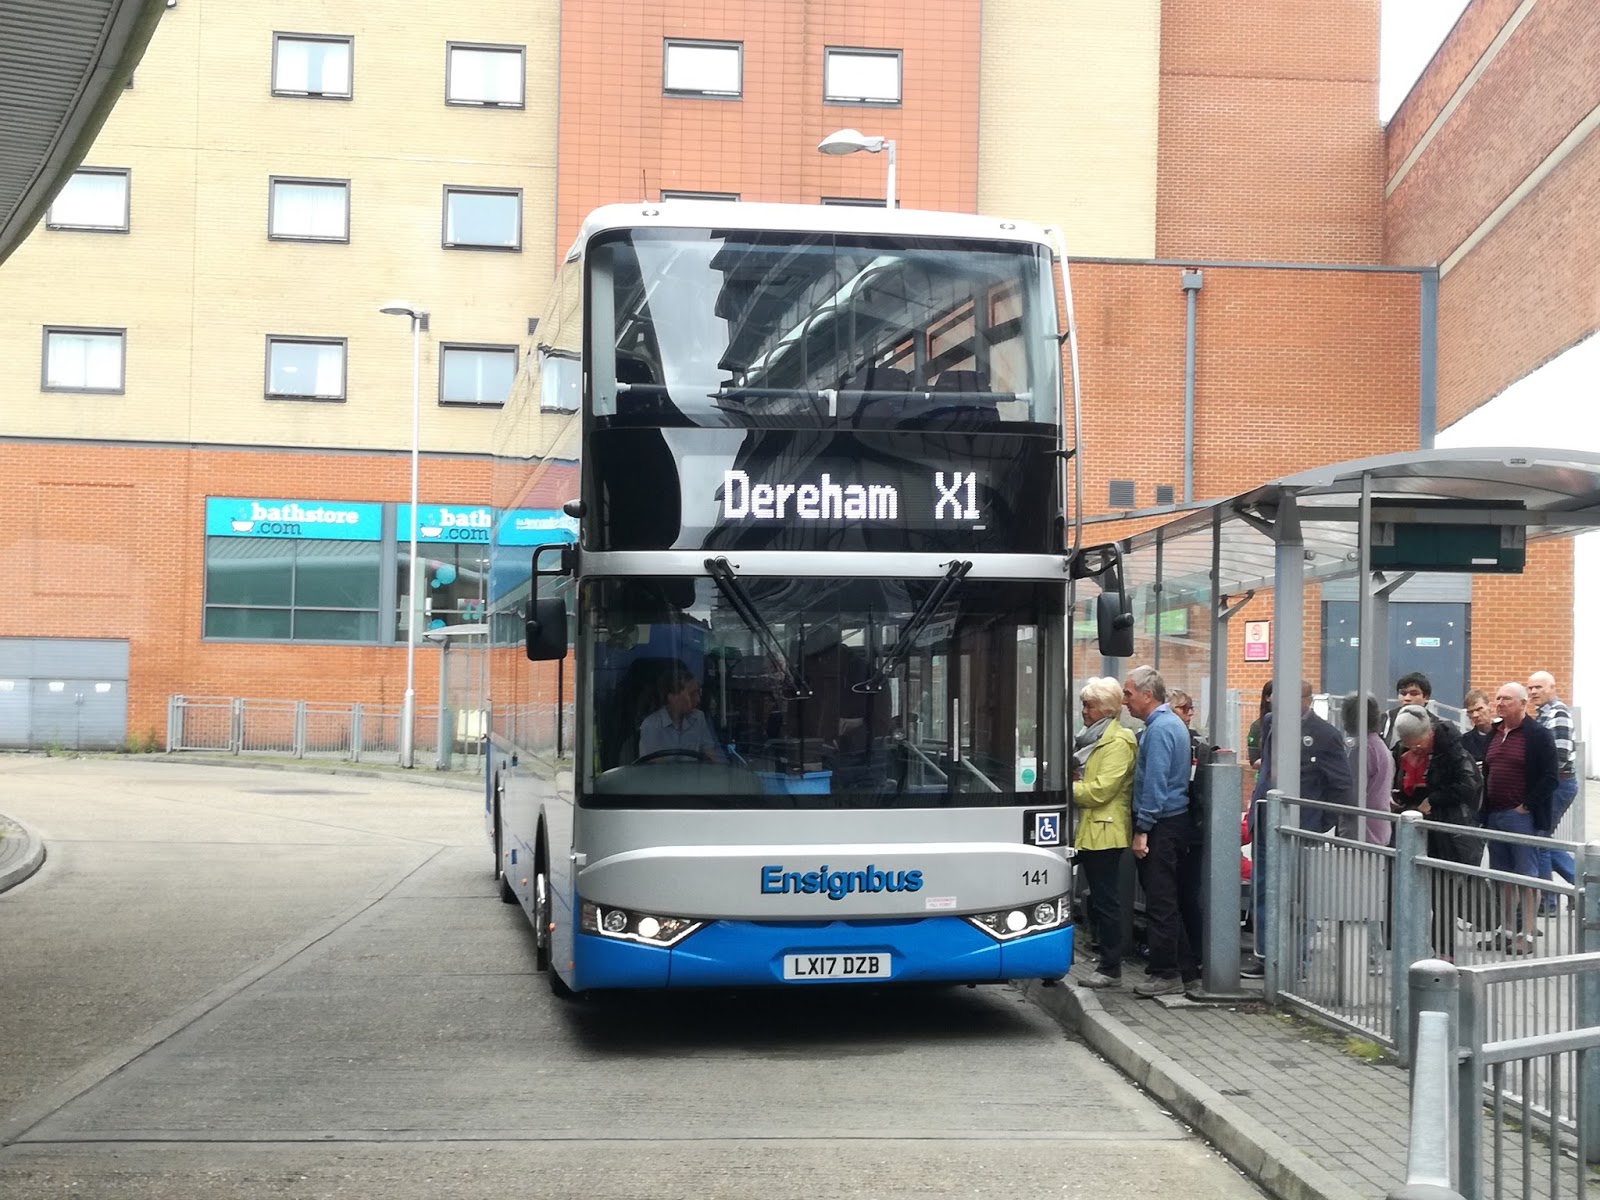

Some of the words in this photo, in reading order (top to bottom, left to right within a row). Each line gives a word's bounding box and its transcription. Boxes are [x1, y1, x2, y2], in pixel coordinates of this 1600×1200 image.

[724, 470, 898, 519] Dereham
[935, 471, 980, 519] X1
[251, 502, 360, 524] bathstore
[257, 521, 302, 536] .com
[445, 527, 489, 541] .com
[760, 864, 924, 901] Ensignbus
[1021, 869, 1049, 886] 141
[795, 957, 837, 976] LX17
[843, 956, 880, 974] DZB
